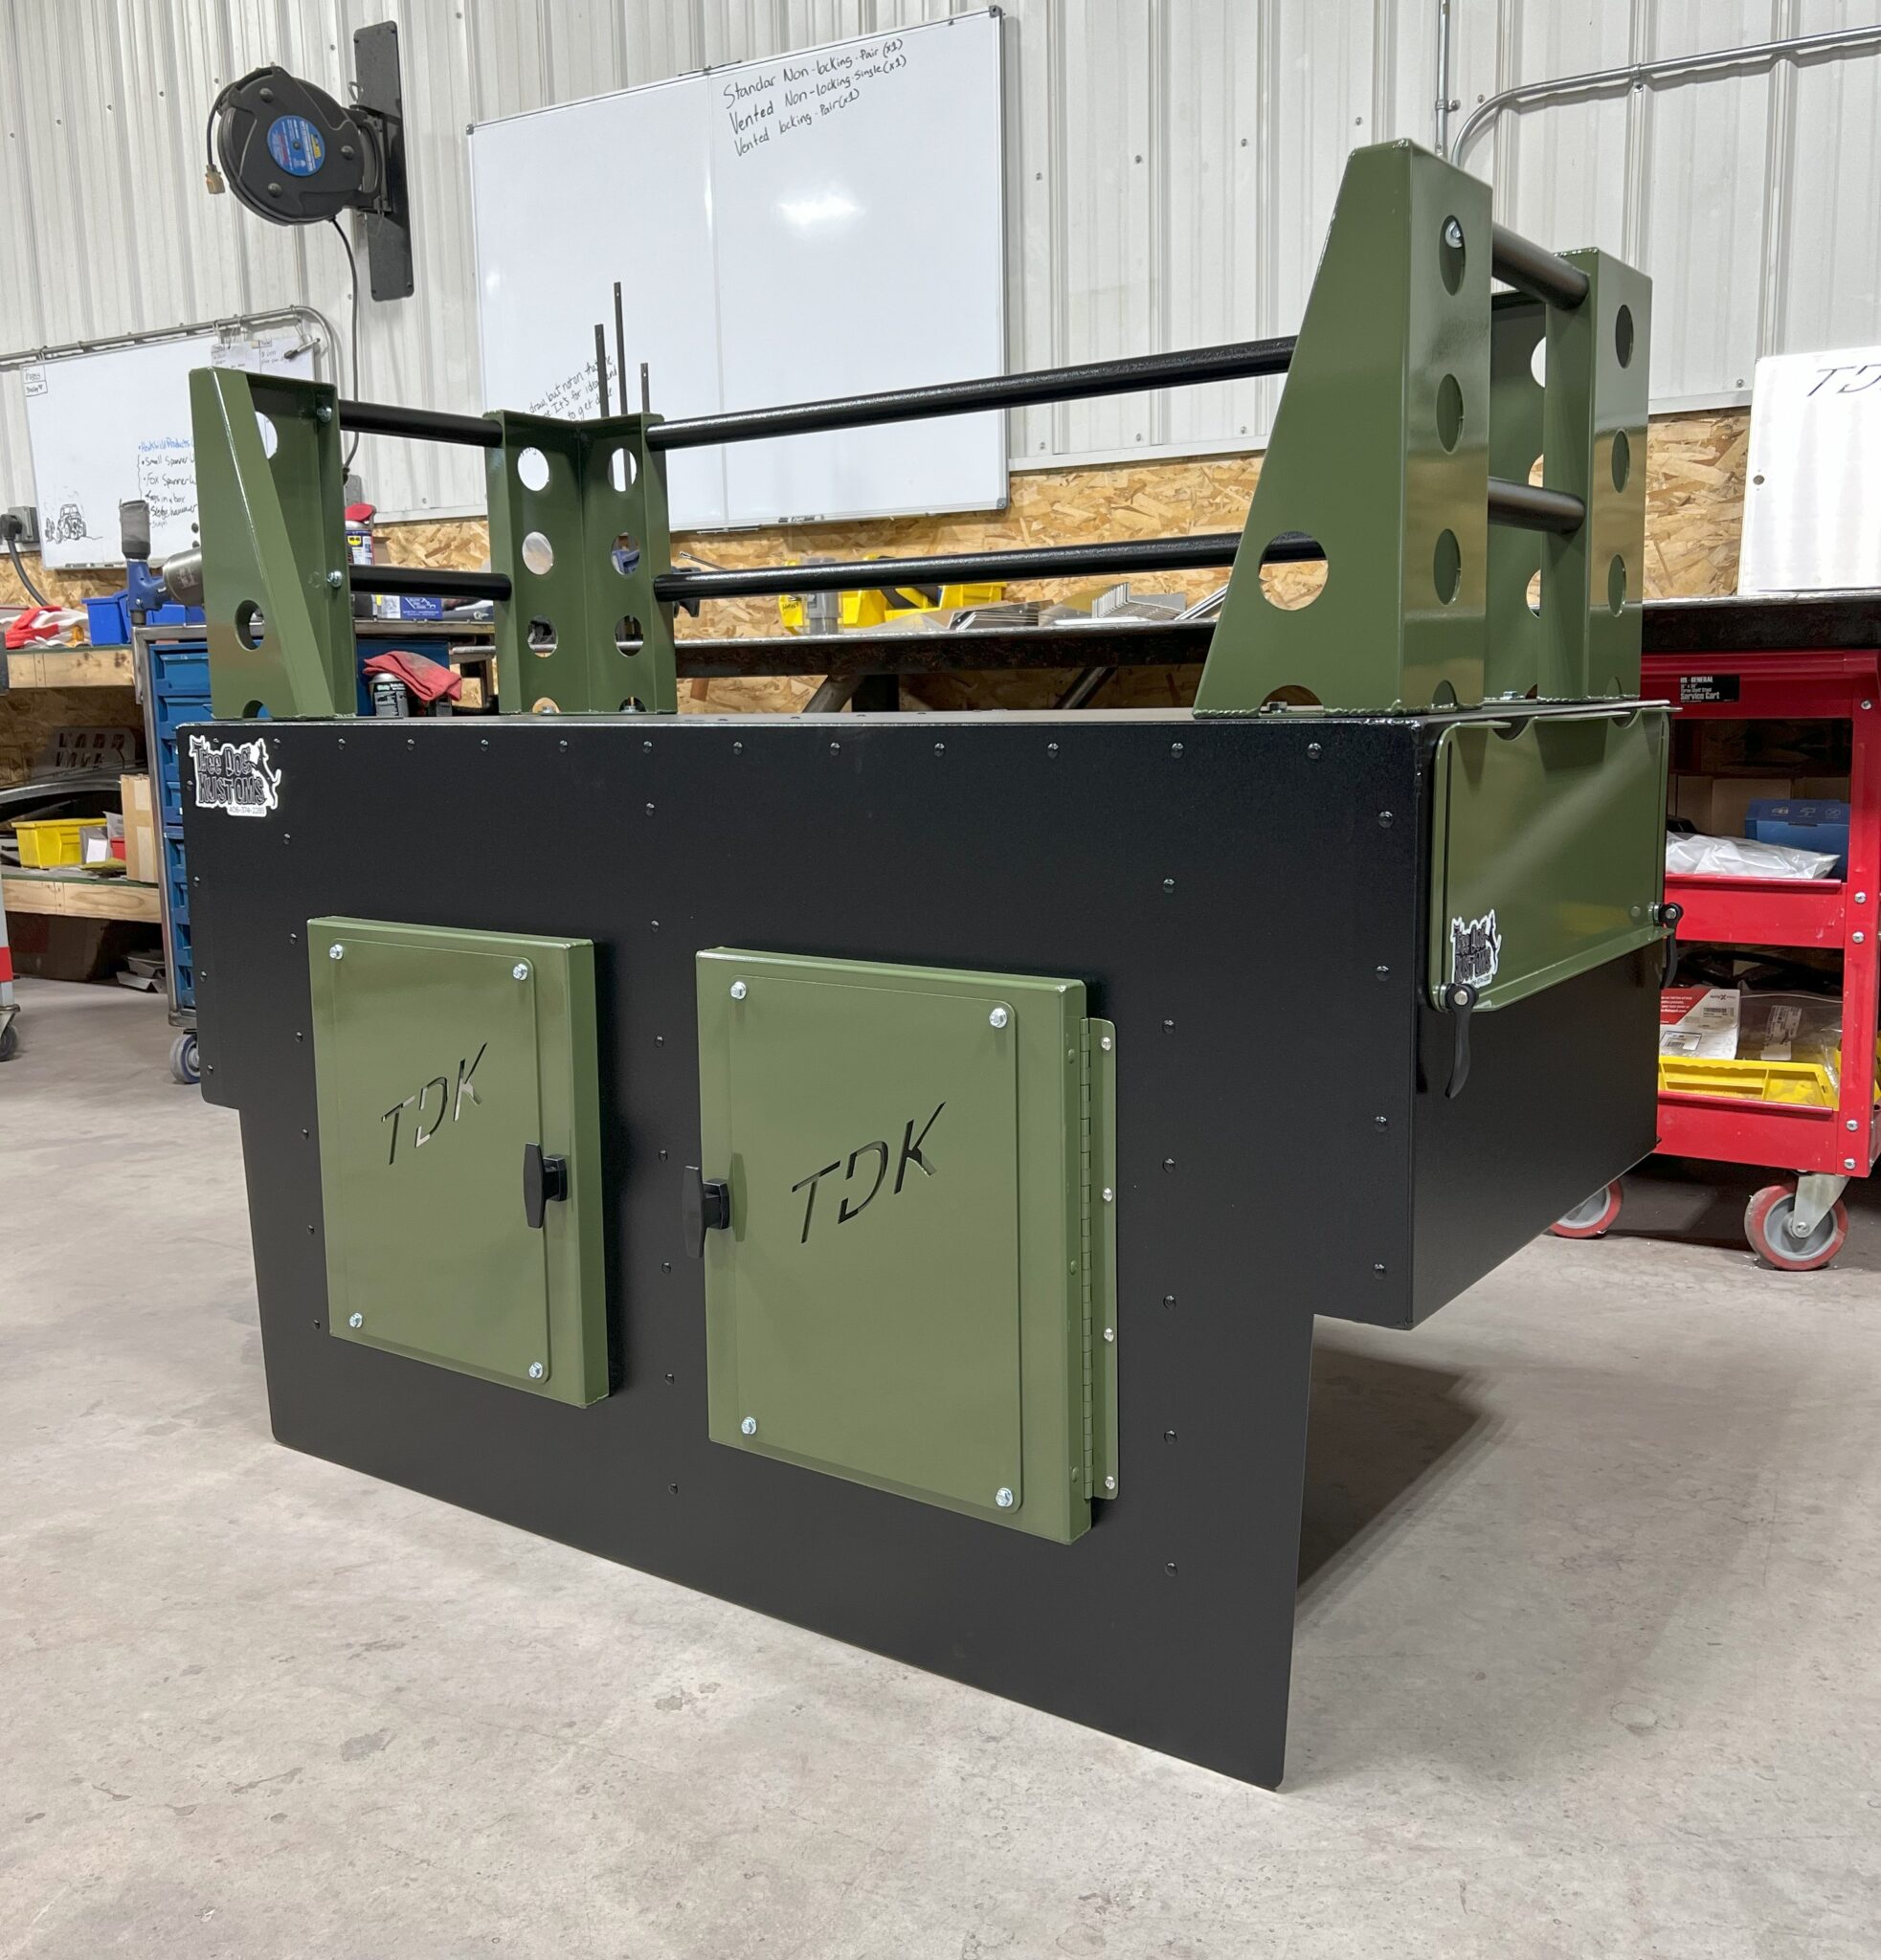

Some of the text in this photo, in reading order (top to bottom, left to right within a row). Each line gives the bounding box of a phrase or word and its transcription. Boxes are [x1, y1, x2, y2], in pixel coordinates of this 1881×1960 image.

[729, 100, 774, 135] Vented
[734, 126, 770, 157] Vented
[382, 1042, 488, 1165] TDK
[792, 1102, 946, 1243] TDK
